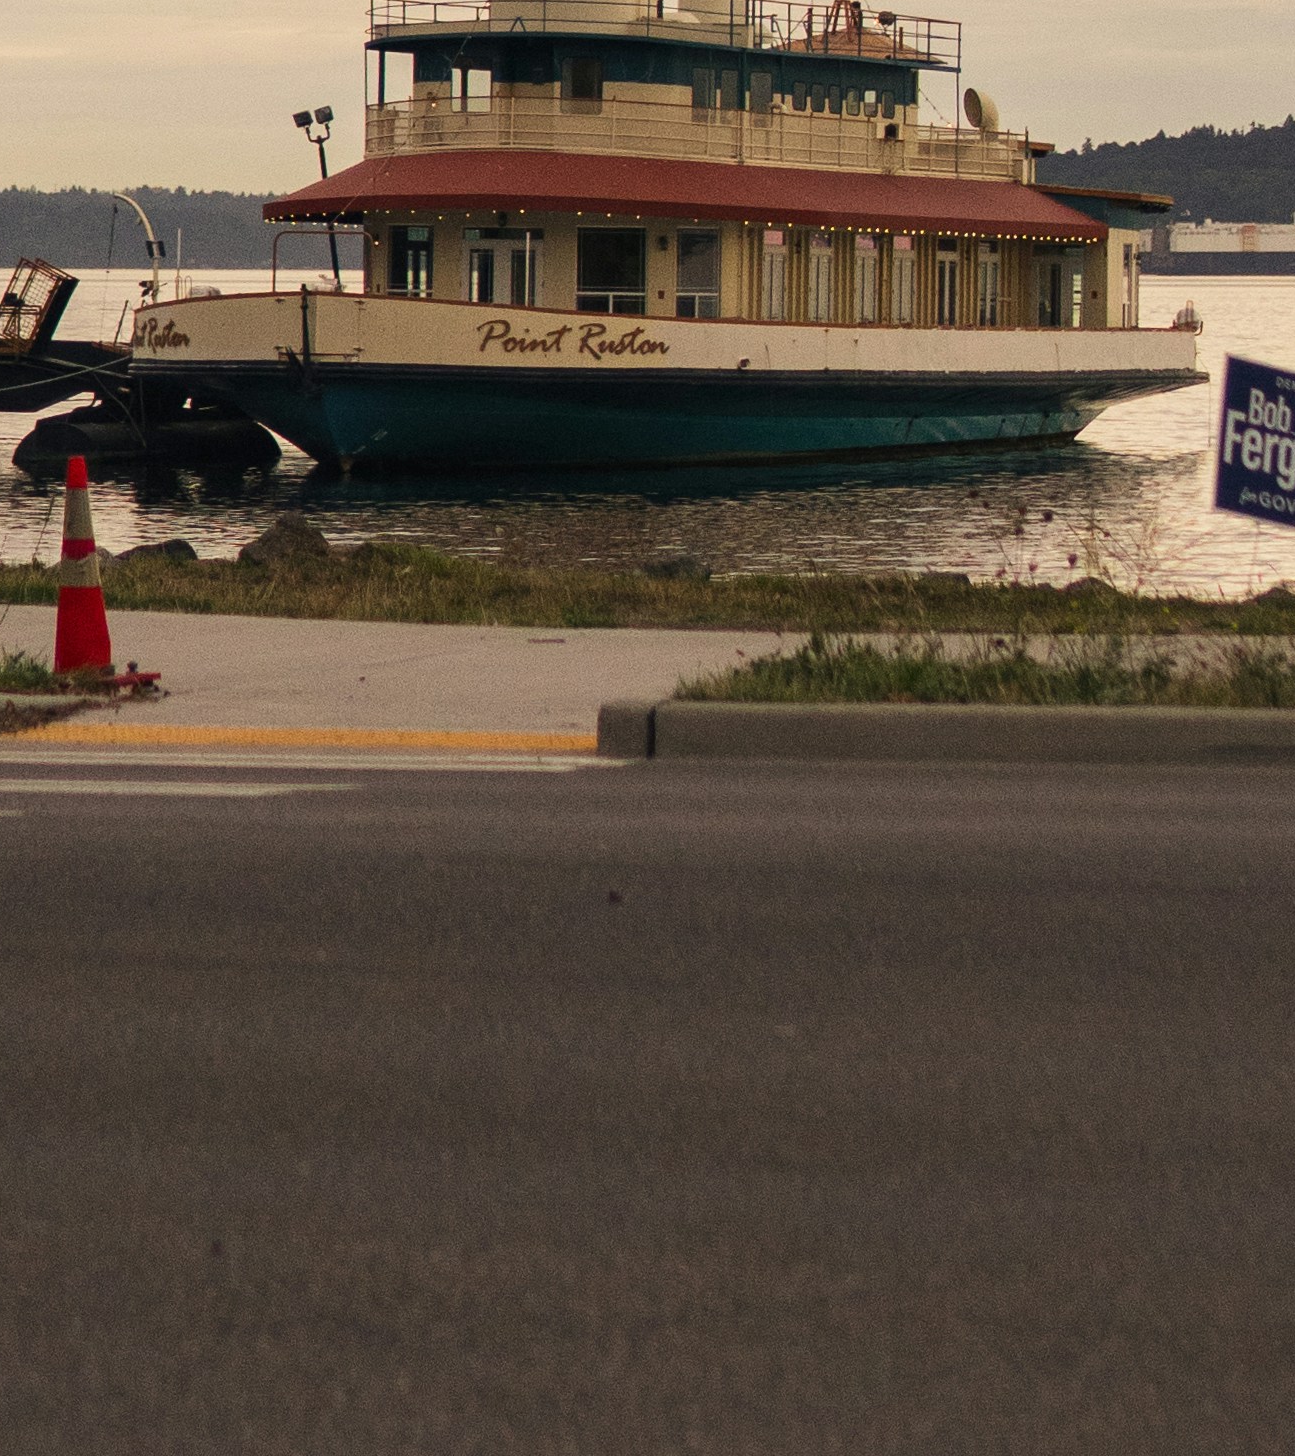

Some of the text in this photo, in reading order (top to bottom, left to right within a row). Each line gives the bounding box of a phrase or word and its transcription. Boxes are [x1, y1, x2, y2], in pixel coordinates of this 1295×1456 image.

[476, 319, 671, 360] Point Ruston
[1247, 387, 1292, 433] Bob
